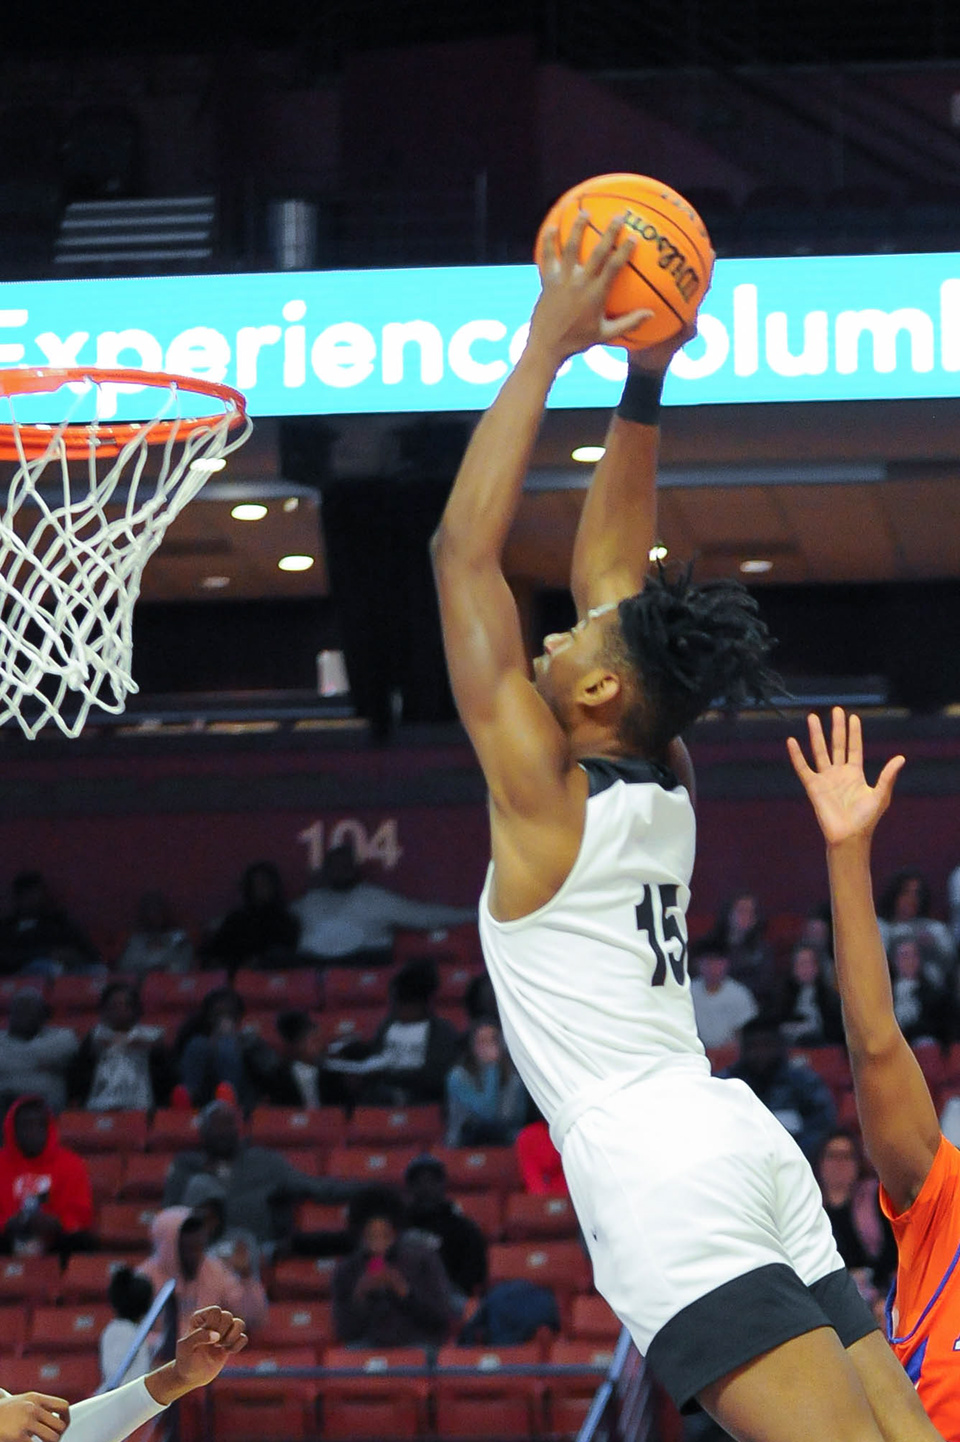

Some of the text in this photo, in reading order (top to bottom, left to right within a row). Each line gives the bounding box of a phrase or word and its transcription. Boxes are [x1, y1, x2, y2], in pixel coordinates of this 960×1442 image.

[623, 209, 701, 303] Wilson
[296, 818, 402, 871] 104
[634, 883, 688, 987] 15
